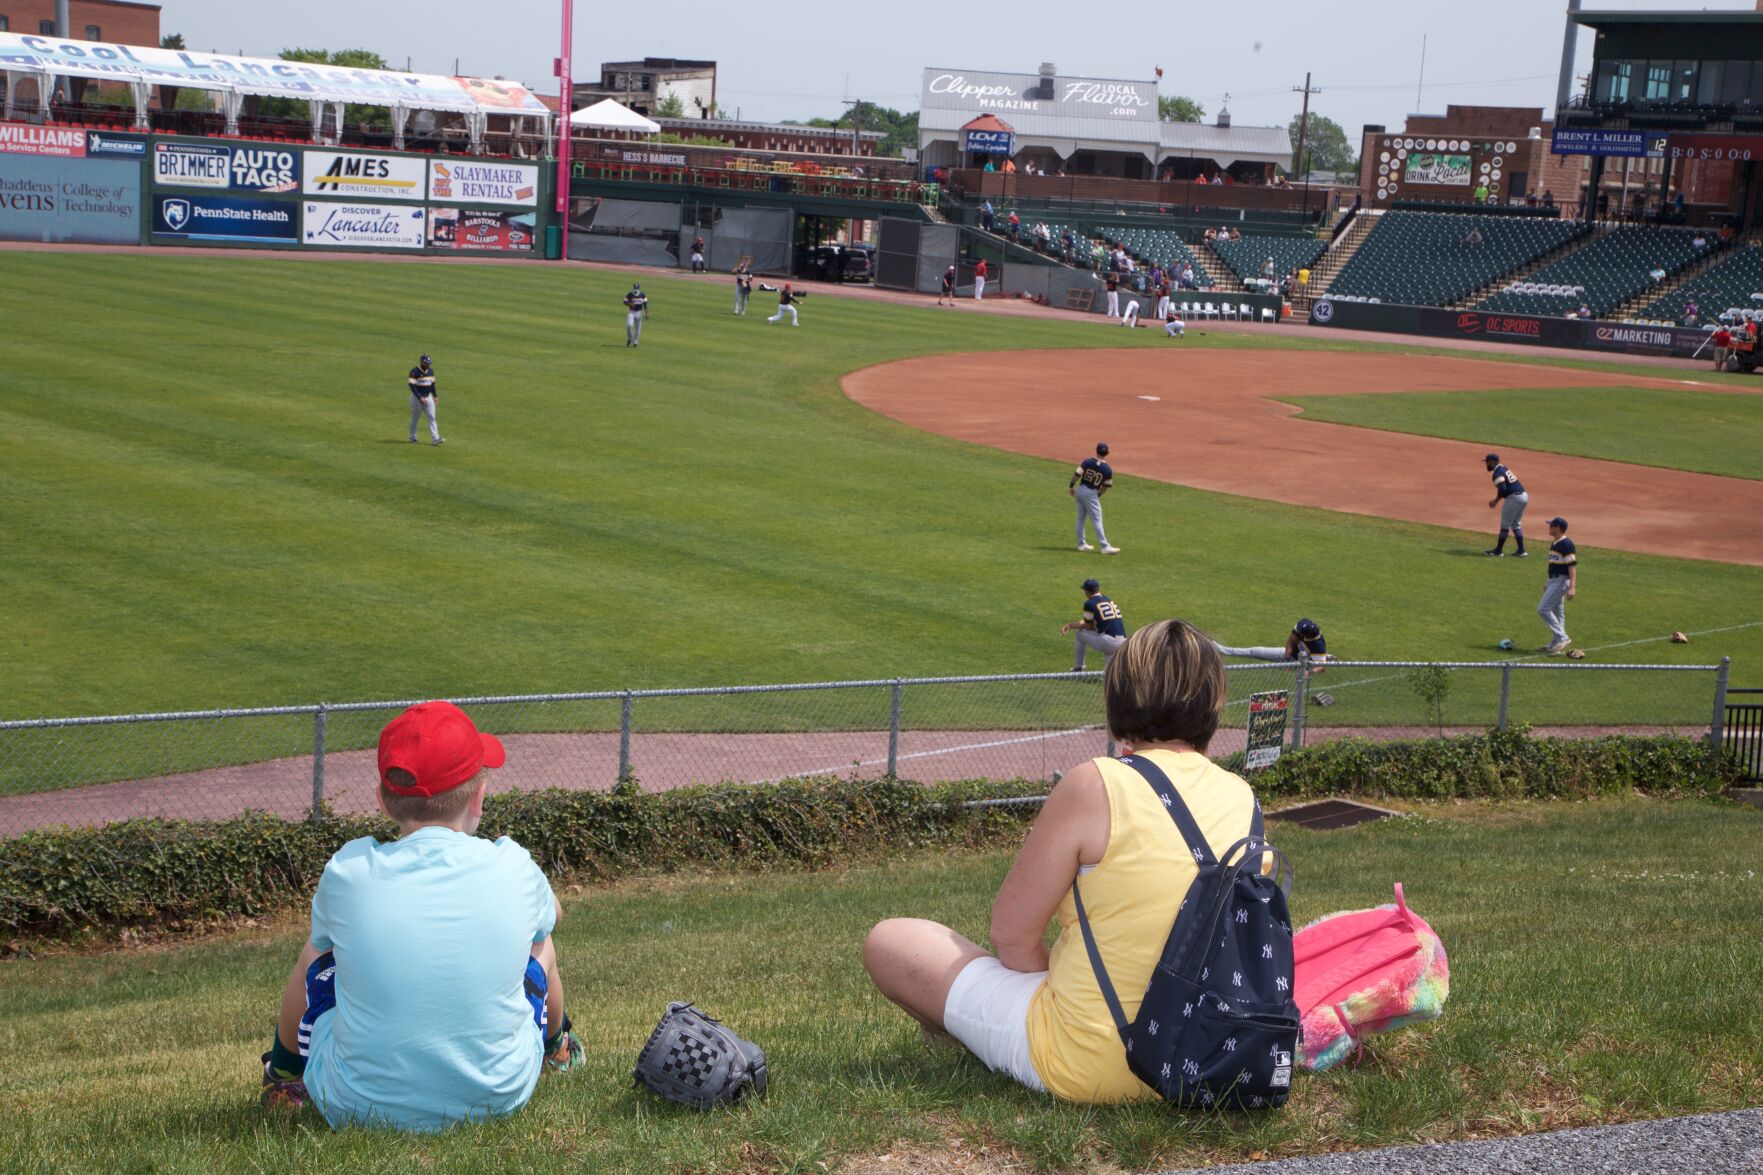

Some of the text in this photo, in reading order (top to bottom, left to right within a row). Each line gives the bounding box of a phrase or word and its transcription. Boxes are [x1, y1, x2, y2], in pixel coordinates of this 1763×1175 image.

[21, 36, 141, 63] Cool
[177, 52, 421, 86] Lancaster
[929, 74, 1017, 98] Clipper
[1101, 84, 1136, 96] LOCAL
[1062, 81, 1150, 107] Flavor
[979, 98, 1039, 111] MAGAZINE
[1110, 107, 1137, 116] .com
[0, 126, 84, 147] WILLIAMS
[1556, 131, 1643, 143] BRENT L. MILLER
[7, 142, 37, 153] Service
[39, 144, 71, 155] Centers
[101, 141, 143, 151] MICHELIN
[1599, 145, 1642, 153] GOLDSMITHS
[1654, 139, 1667, 151] 12
[232, 148, 293, 170] AUTO
[622, 151, 648, 162] HESS'S
[649, 153, 686, 165] BARBECUE
[1671, 147, 1683, 158] B:
[1686, 147, 1694, 158] 0
[1700, 147, 1712, 159] S:
[1715, 147, 1723, 159] 0
[159, 153, 225, 179] BRIMMER
[232, 167, 293, 187] TAGS
[317, 156, 390, 191] AMES
[453, 166, 523, 184] SLAYMAKER
[1405, 170, 1432, 182] DRINK
[0, 178, 53, 192] haddeus
[62, 183, 125, 200] College of
[340, 184, 396, 195] CONSTRUCTION,
[462, 182, 513, 199] RENTALS
[0, 192, 55, 211] vens
[63, 199, 135, 218] Technology
[252, 209, 289, 222] Health
[342, 207, 381, 215] DISCOVER
[318, 209, 400, 241] Lancaster
[464, 217, 501, 228] BARSTOOLS
[466, 233, 499, 243] BILLIARDS
[1316, 304, 1330, 317] 42
[1486, 317, 1540, 334] OC SPORTS
[1235, 908, 1249, 923] NY
[1262, 944, 1273, 958] NY
[1276, 976, 1289, 991] NY
[1223, 1037, 1237, 1051] NY
